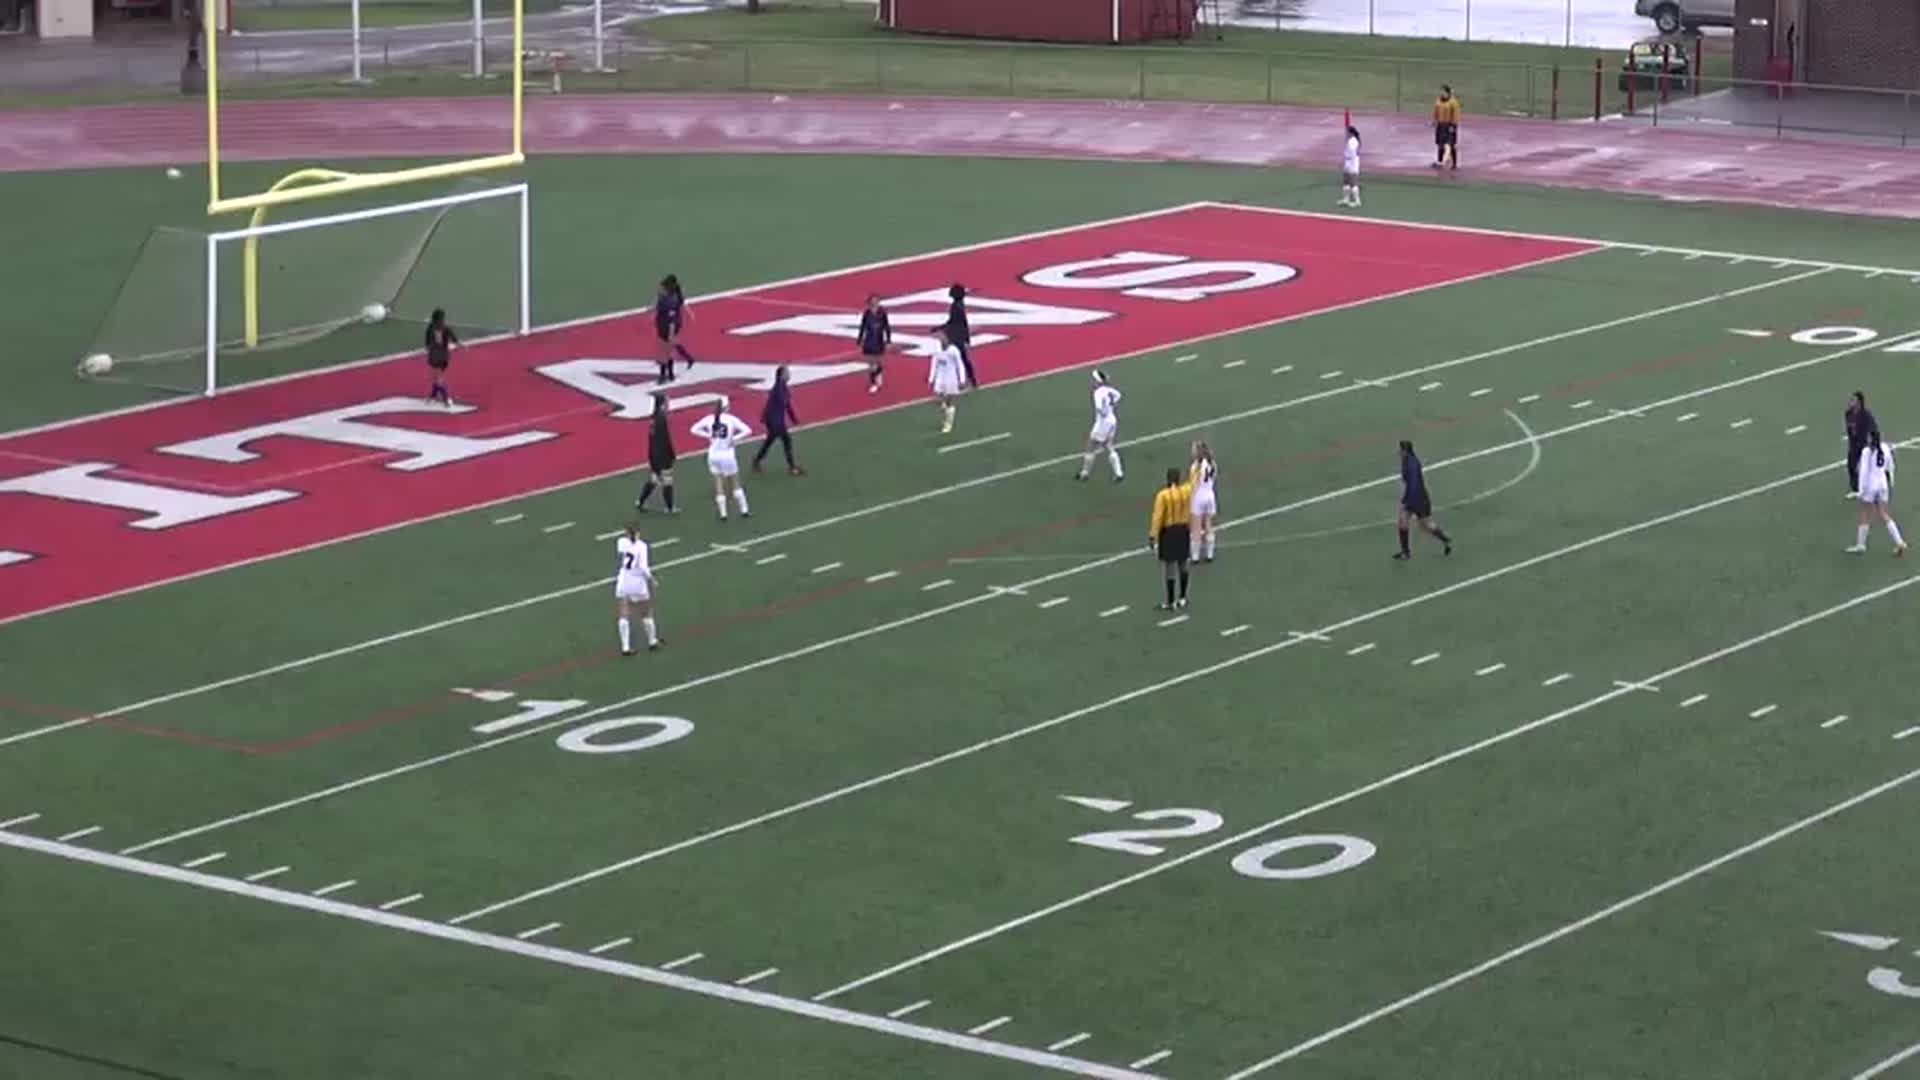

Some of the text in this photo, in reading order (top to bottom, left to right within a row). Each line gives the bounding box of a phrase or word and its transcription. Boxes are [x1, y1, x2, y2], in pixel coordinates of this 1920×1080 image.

[0, 252, 1298, 566] ITANS
[625, 551, 635, 569] 7
[471, 699, 695, 754] 10
[1067, 807, 1376, 879] 20
